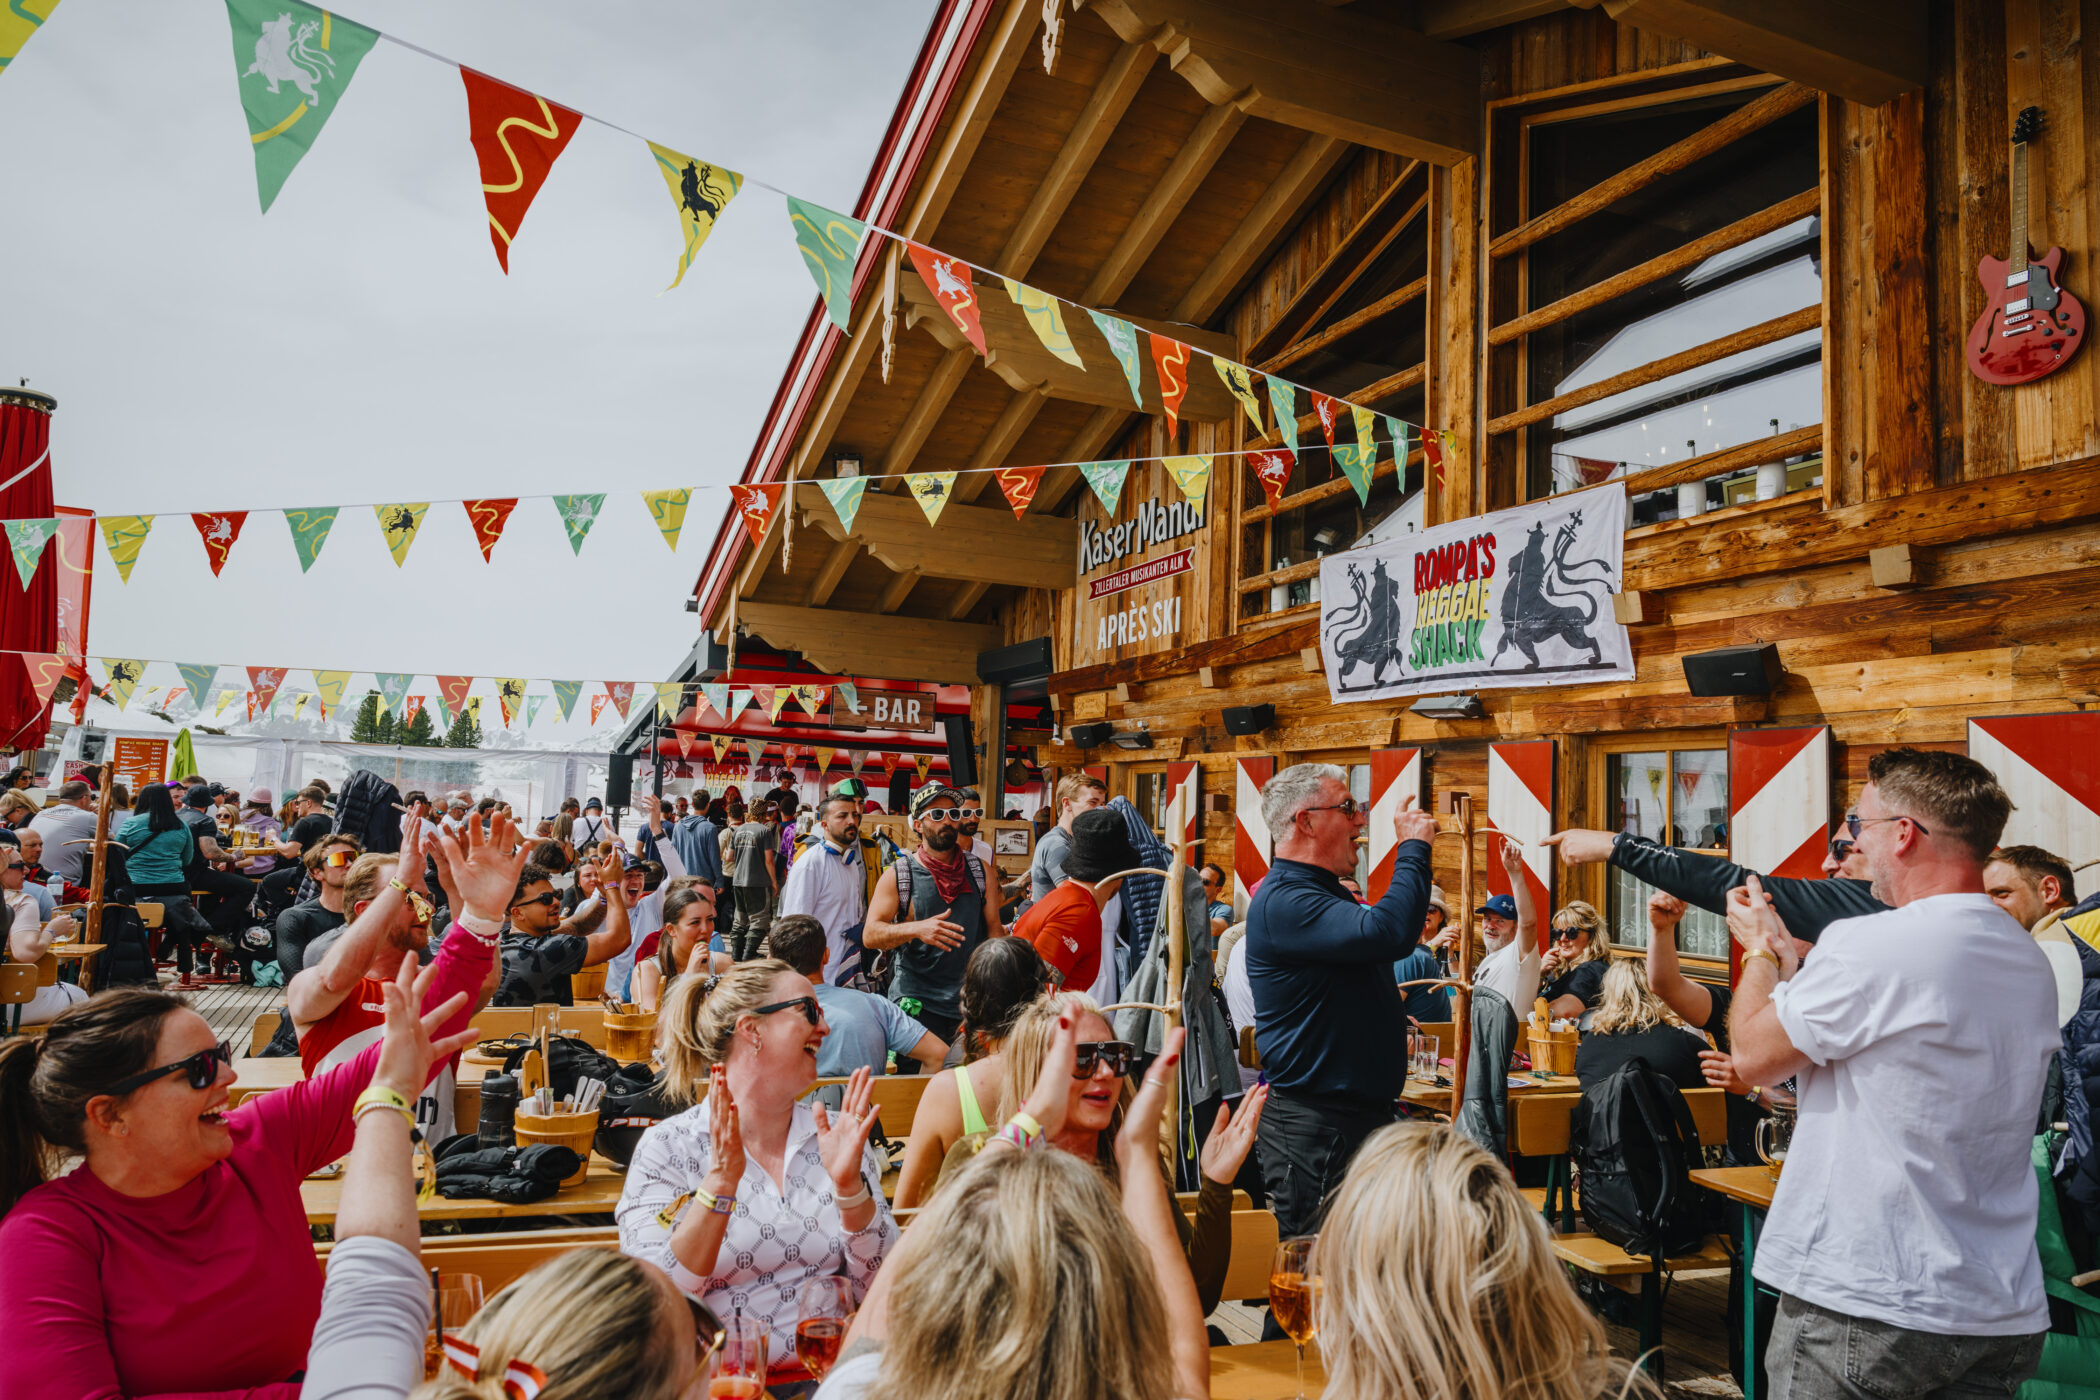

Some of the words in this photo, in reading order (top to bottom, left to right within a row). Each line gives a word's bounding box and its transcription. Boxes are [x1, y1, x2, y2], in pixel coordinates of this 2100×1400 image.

[1080, 518, 1137, 575] Kaser
[1414, 532, 1496, 596] ROMPA'S
[1095, 573, 1130, 595] ZILLERTALER
[1130, 559, 1169, 584] MUSIKANTEN
[1170, 555, 1184, 571] ALM
[1097, 601, 1148, 650] APRÈS
[1152, 596, 1181, 638] SKI
[1416, 577, 1493, 630] REGGAE
[1409, 618, 1486, 672] SHACK
[874, 696, 920, 724] BAR
